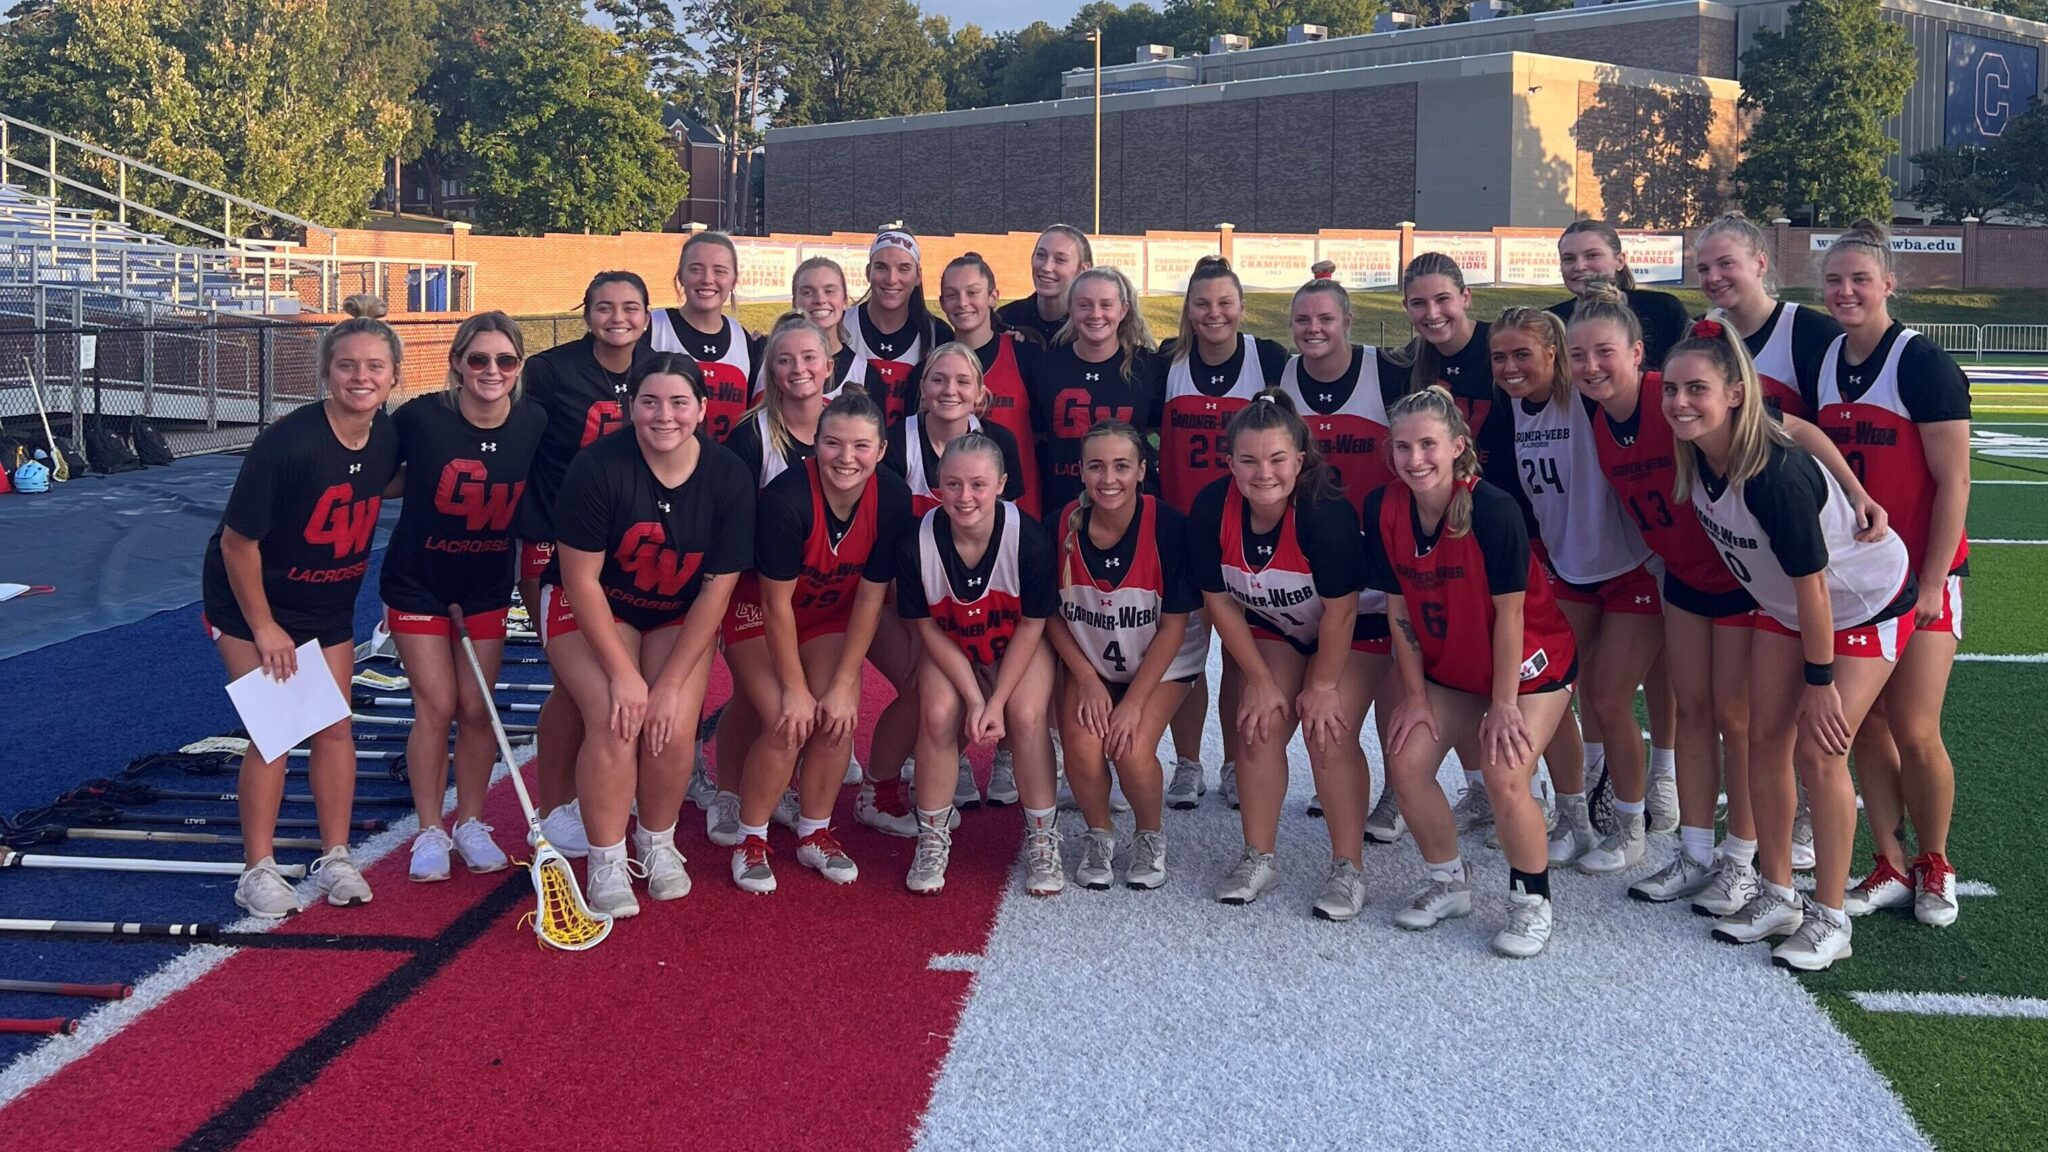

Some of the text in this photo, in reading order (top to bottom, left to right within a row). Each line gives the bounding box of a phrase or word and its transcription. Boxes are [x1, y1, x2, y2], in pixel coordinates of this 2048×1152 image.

[1974, 51, 2011, 137] C
[1154, 264, 1190, 273] CHAMP
[1240, 260, 1307, 269] CHAMPIONS
[1335, 262, 1391, 271] HAMPIONS
[1629, 256, 1674, 265] ARANCES
[434, 457, 528, 531] GW
[1521, 457, 1567, 494] 24
[303, 482, 381, 559] GW
[1629, 490, 1674, 532] 13
[424, 536, 511, 553] LACROSSE
[613, 521, 705, 597] GW
[1421, 602, 1448, 641] 6
[1103, 641, 1127, 672] 4
